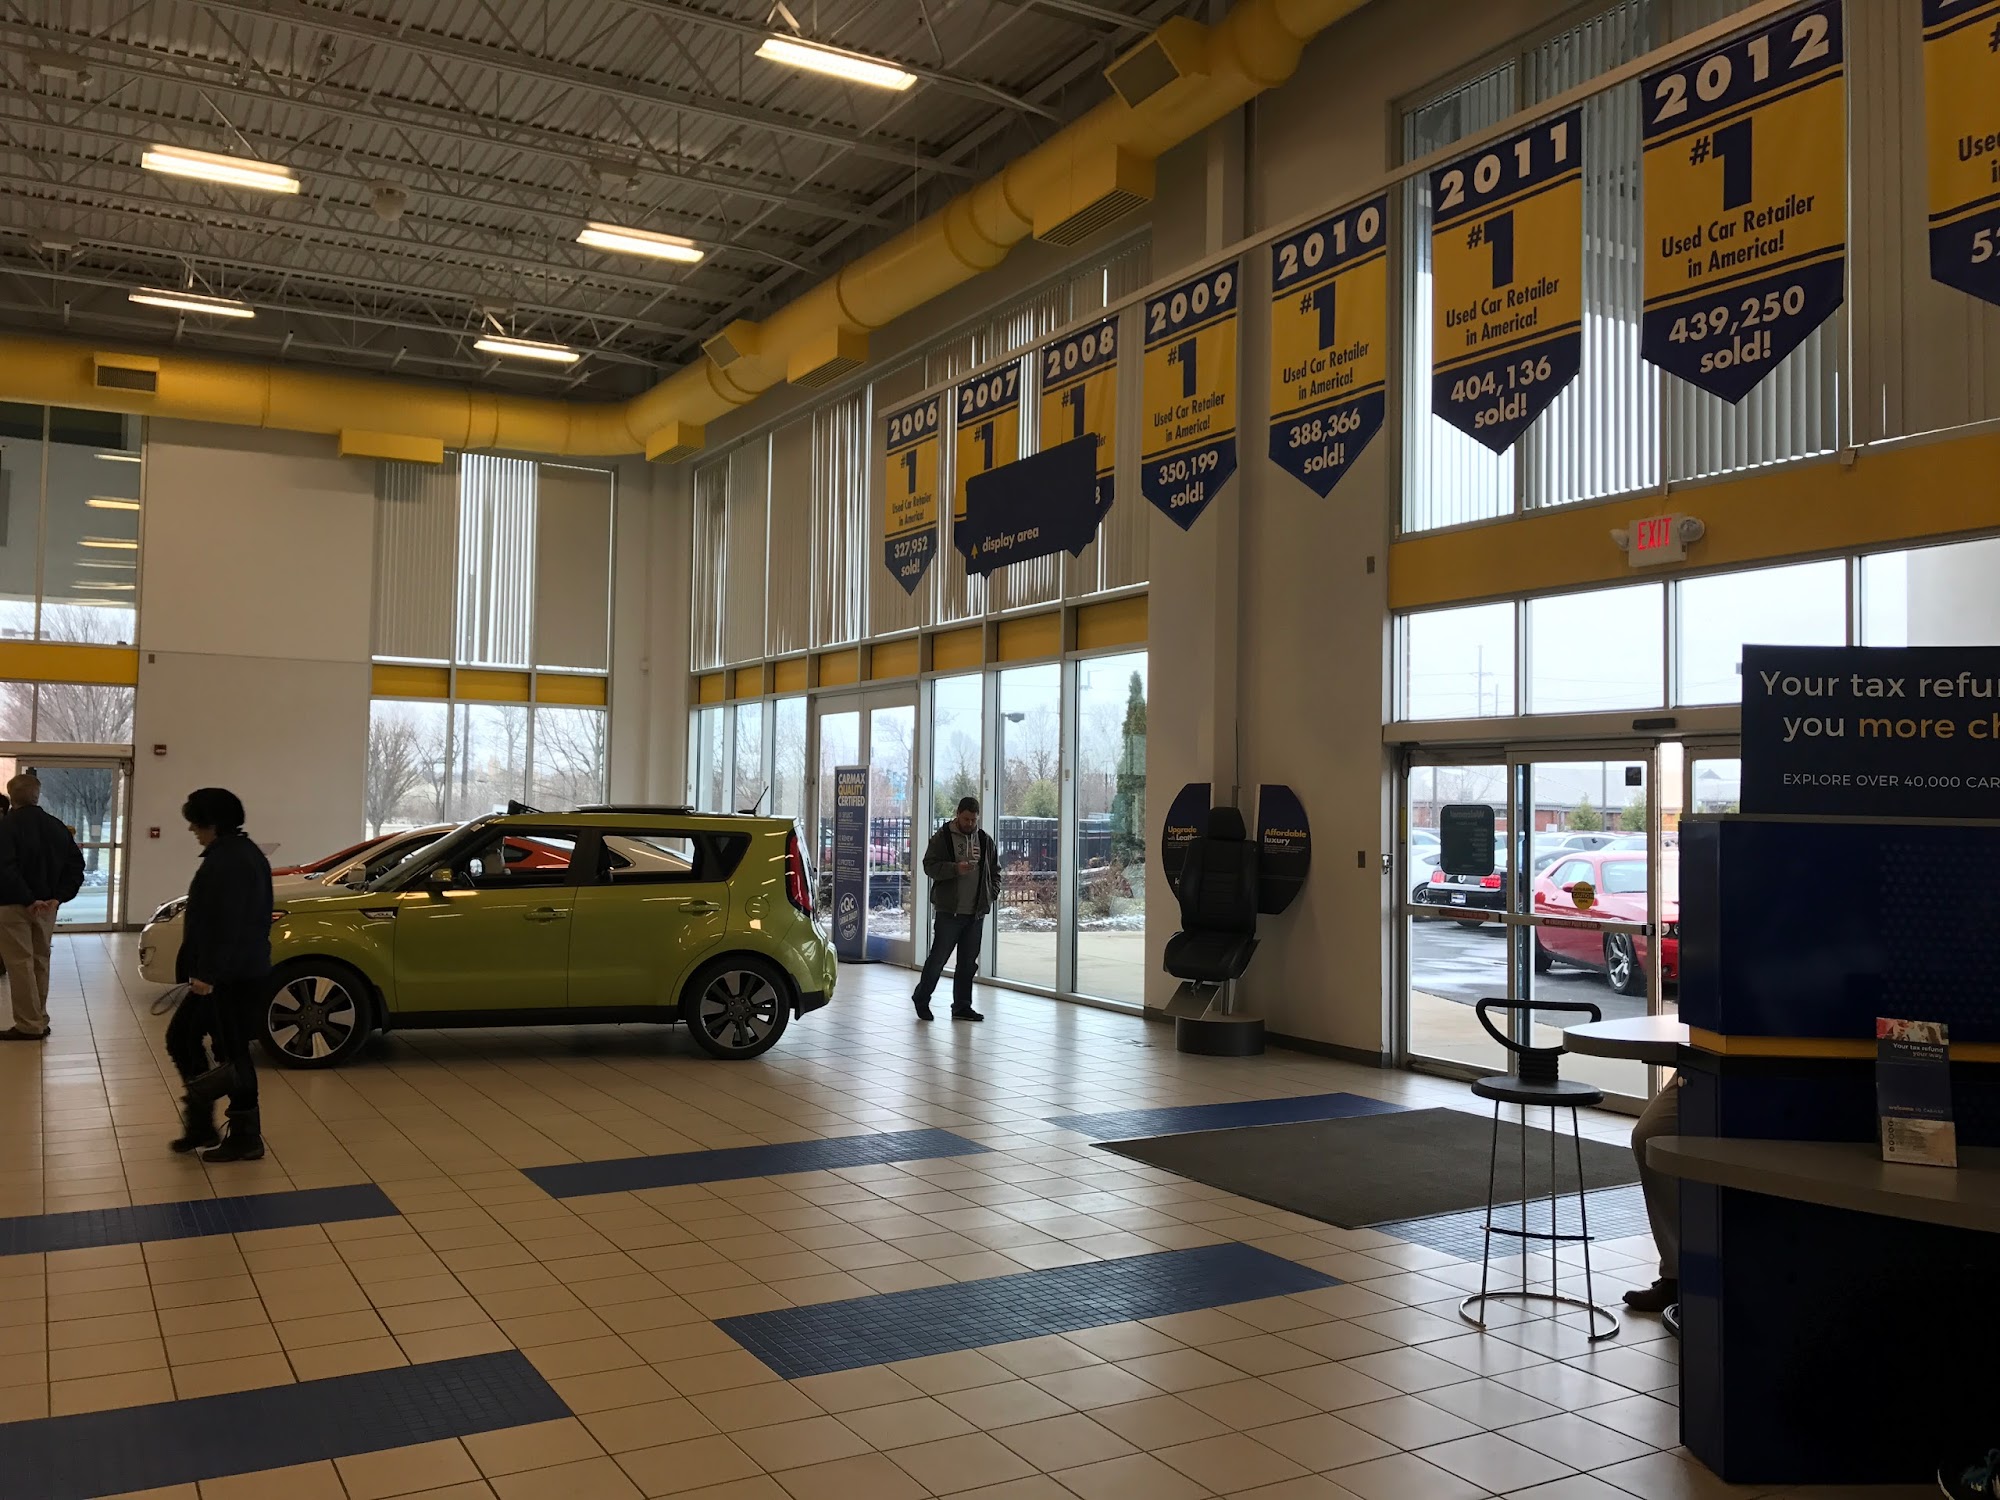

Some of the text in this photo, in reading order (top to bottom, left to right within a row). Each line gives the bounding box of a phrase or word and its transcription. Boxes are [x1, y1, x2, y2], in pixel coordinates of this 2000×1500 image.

[1652, 13, 1830, 125] 2012
[1958, 130, 2000, 161] Use
[1437, 121, 1568, 212] 2011
[1689, 116, 1753, 212] #1
[1277, 206, 1380, 281] 2010
[1661, 194, 1815, 258] Used Car Retailer
[1466, 209, 1514, 290] #1
[1687, 230, 1784, 279] in America!
[1149, 272, 1233, 335] 2009
[1299, 281, 1337, 351] #1
[1445, 277, 1560, 328] Used Car Retailer
[1668, 285, 1805, 345] 439,250
[1465, 307, 1538, 347] in America!
[1046, 325, 1114, 380] 2008
[1167, 336, 1197, 399] #1
[1283, 341, 1370, 384] Used Car Retailer
[1700, 330, 1772, 374] sold!
[961, 368, 1018, 415] 2007
[1298, 371, 1354, 401] in America!
[1450, 355, 1552, 403] 404,136
[890, 401, 937, 444] 2006
[1061, 382, 1085, 439] #1
[1154, 392, 1225, 428] Used Car Retailer
[1288, 408, 1361, 448] 388,366
[1474, 393, 1528, 429] sold!
[974, 420, 994, 470] #1
[1165, 415, 1211, 442] in America!
[900, 448, 918, 495] #1
[1158, 450, 1219, 485] 350,199
[1303, 442, 1345, 474] sold!
[892, 501, 904, 515] Used
[913, 492, 932, 508] Retailer
[1170, 481, 1204, 509] sold!
[898, 509, 924, 527] in America!
[1637, 517, 1672, 551] EXIT
[894, 535, 928, 559] 327,952
[982, 526, 1039, 553] display area
[901, 558, 920, 577] sold!
[1760, 670, 2000, 698] Your tax refu
[1782, 716, 1845, 743] you
[1859, 717, 1955, 739] more
[837, 784, 864, 796] QUALITY
[838, 773, 866, 785] CARMAX
[1783, 773, 2000, 789] EXPLORE OVER 40,000 CAR
[837, 795, 866, 807] CERTIFIED
[1167, 826, 1197, 835] Upgrade
[1264, 828, 1307, 838] Affordable
[1264, 836, 1290, 847] luxury
[1893, 1042, 1909, 1050] Your
[1921, 1045, 1944, 1053] refund
